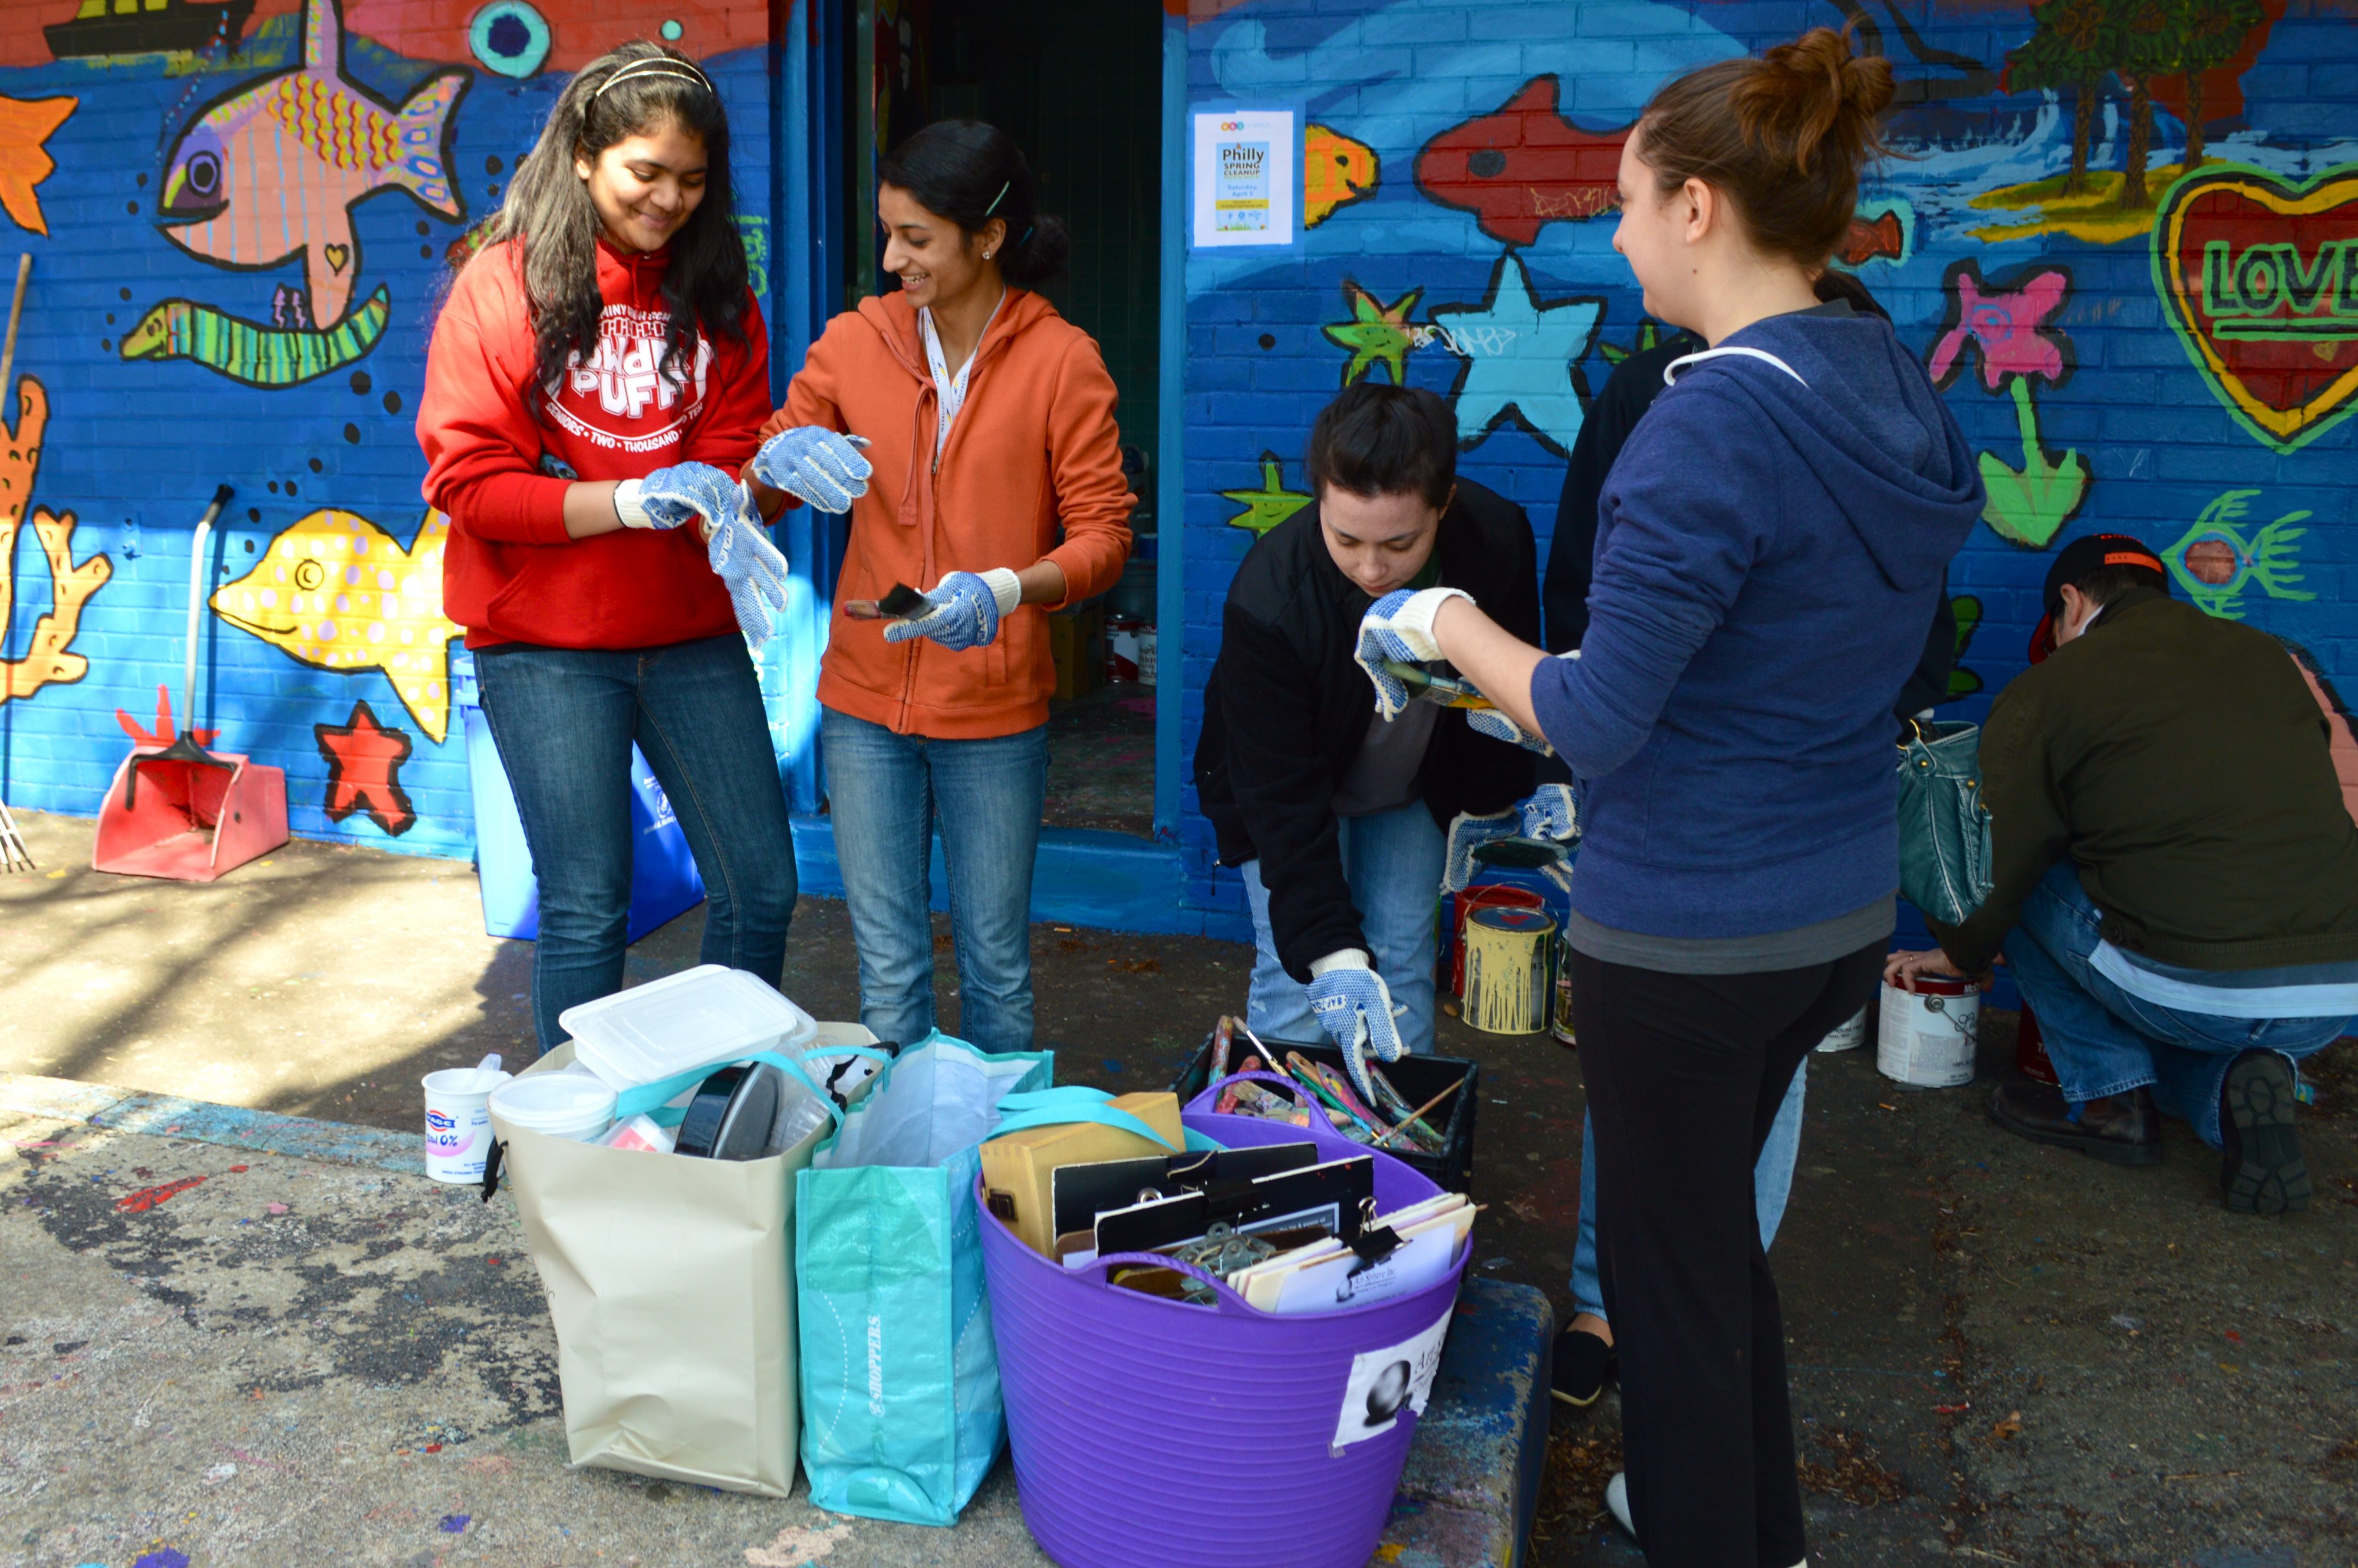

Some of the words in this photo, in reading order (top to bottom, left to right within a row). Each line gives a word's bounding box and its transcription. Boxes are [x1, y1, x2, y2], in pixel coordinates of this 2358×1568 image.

[1223, 148, 1264, 163] Philly
[2202, 238, 2358, 317] LOVE
[571, 368, 690, 419] PUFF
[545, 402, 585, 437] SENIORS
[590, 431, 616, 449] TWO
[623, 430, 680, 453] THOUSAND
[440, 1135, 458, 1147] 0%
[867, 1315, 882, 1404] SHOPPERS
